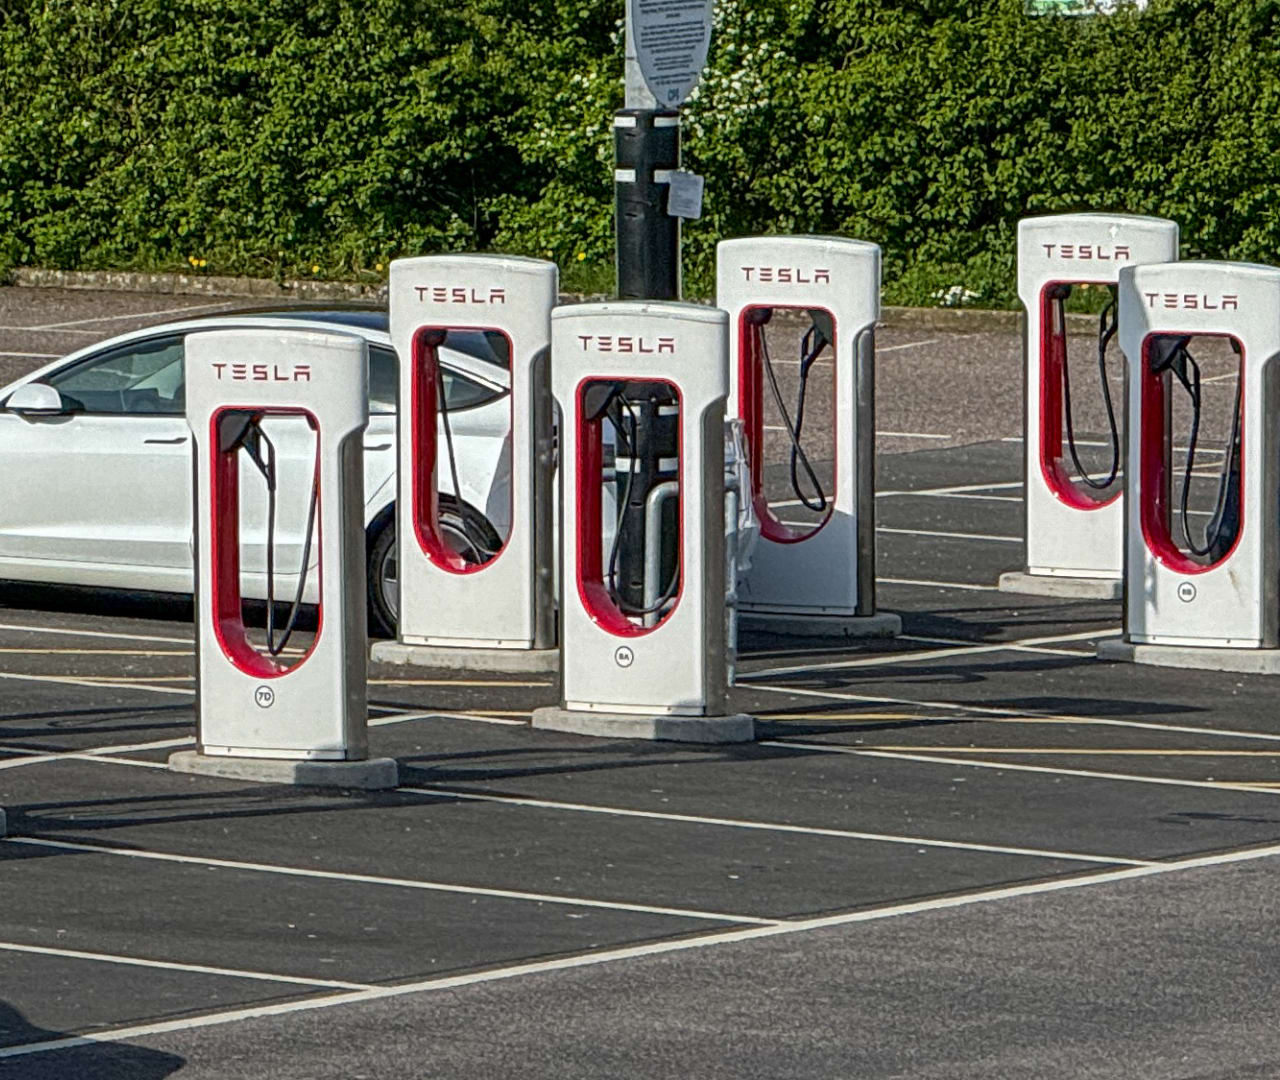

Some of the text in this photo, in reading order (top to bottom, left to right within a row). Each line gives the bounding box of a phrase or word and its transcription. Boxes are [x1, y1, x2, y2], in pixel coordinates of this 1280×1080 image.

[1043, 245, 1129, 260] TESLA
[741, 267, 829, 284] TESLA
[415, 287, 504, 304] TESLA
[1145, 293, 1238, 310] TESLA
[578, 336, 674, 353] TESLA
[212, 363, 310, 381] TESLA
